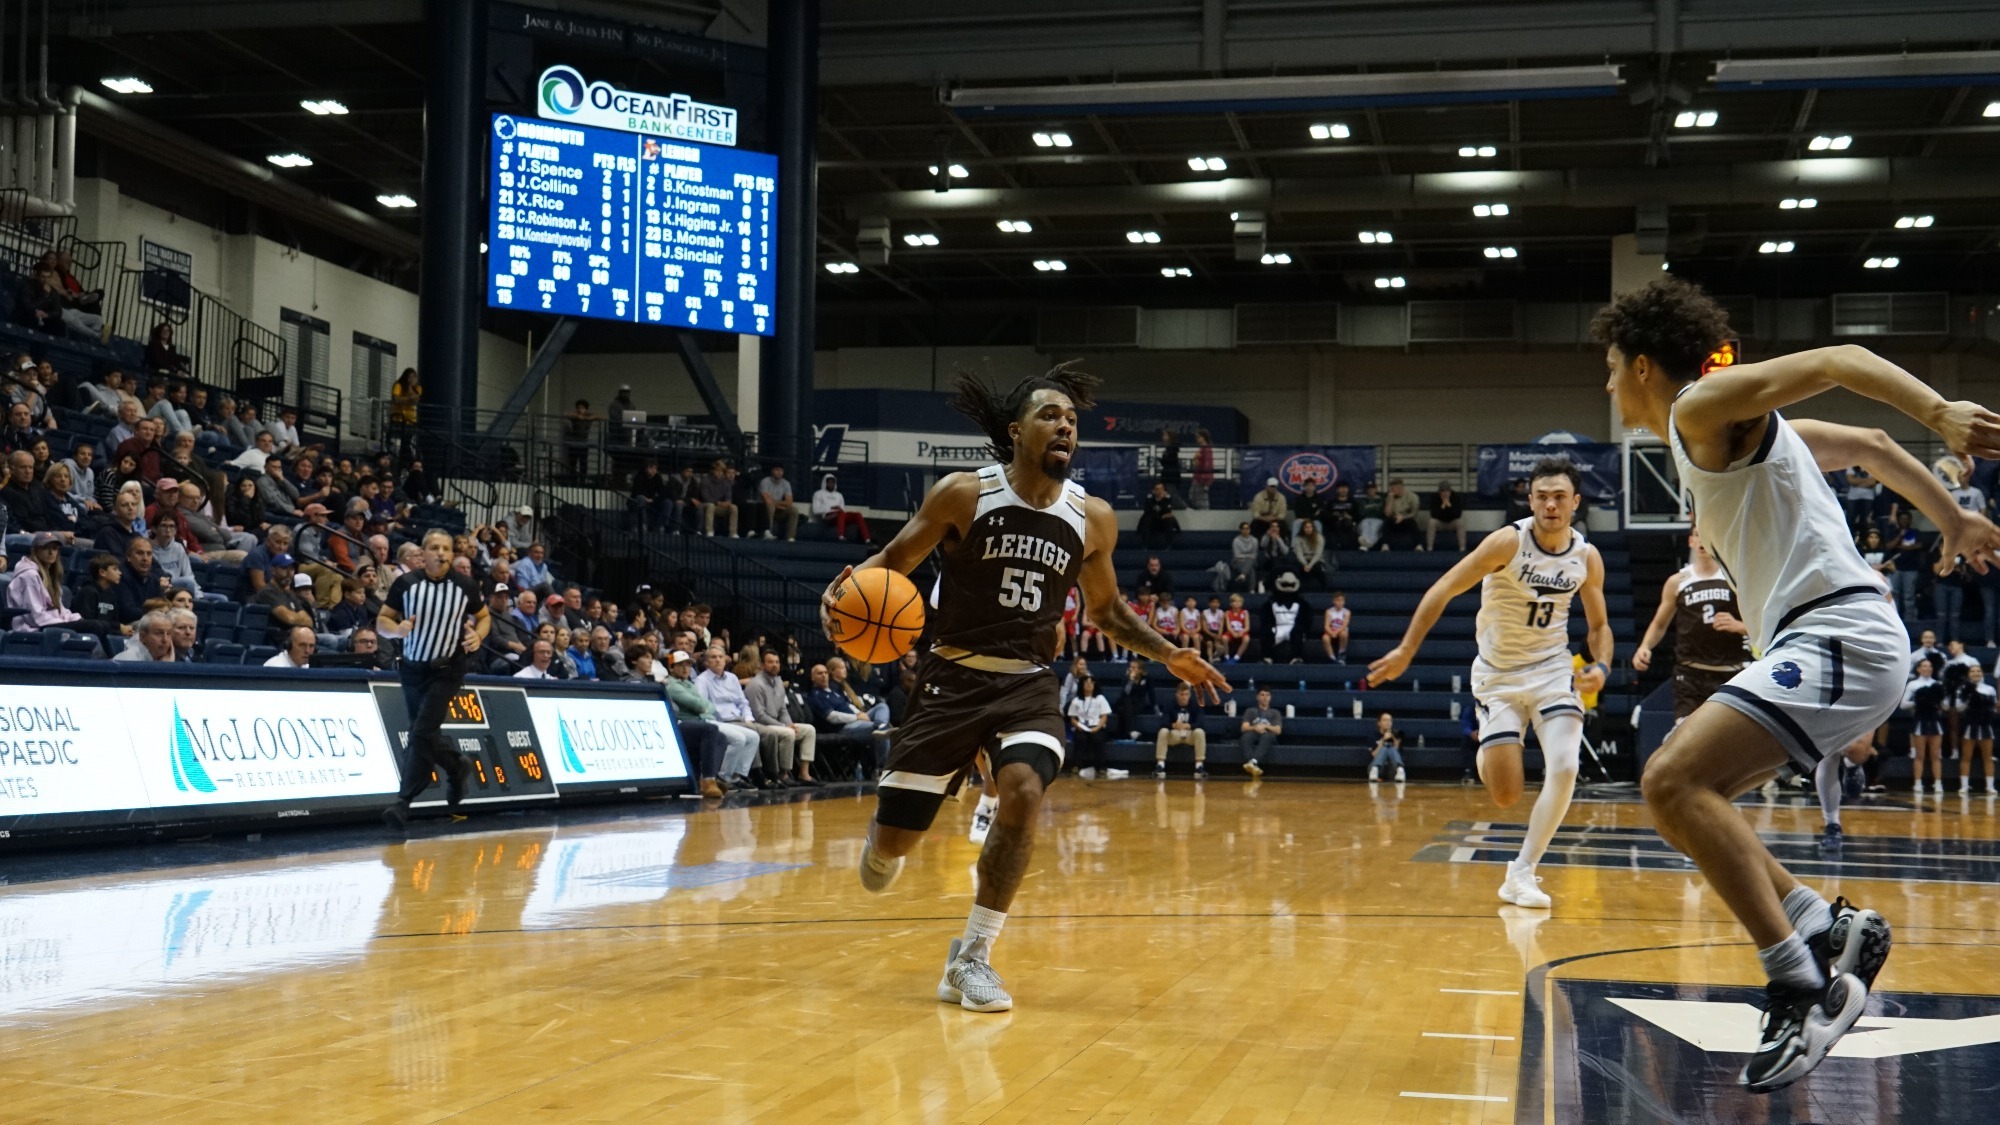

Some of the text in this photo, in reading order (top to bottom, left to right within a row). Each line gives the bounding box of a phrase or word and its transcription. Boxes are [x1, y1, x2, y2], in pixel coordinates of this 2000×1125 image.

[517, 122, 585, 146] MONMOUTH
[628, 117, 733, 143] BANK CENTER
[518, 142, 560, 162] PLAYER
[593, 152, 615, 169] PTS
[617, 156, 637, 173] FLS
[661, 143, 700, 163] LEHIGH
[499, 155, 630, 187] 3 J.Spence 2 1
[663, 163, 702, 182] PLAYER
[733, 173, 754, 190] PTS
[755, 176, 774, 193] FLS
[499, 172, 630, 203] 13 J.Collins 5 1
[646, 175, 656, 190] 2
[663, 178, 734, 201] B.Knostman
[761, 192, 768, 206] 1
[499, 189, 514, 205] 21
[517, 192, 564, 211] X.Rice
[622, 205, 630, 220] 1
[646, 192, 655, 207] 4
[663, 195, 721, 215] J.Ingram
[761, 208, 768, 222] 1
[498, 206, 515, 222] 23
[516, 209, 576, 230] C.Robinson
[579, 217, 591, 231] Jr.
[622, 222, 629, 237] 1
[663, 212, 716, 232] K.Higgins
[719, 219, 733, 233] Jr.
[737, 221, 751, 236] 14
[760, 224, 768, 239] 1
[498, 223, 515, 240] 25
[601, 236, 611, 251] 4
[622, 239, 629, 254] 1
[663, 228, 724, 249] B.Momah
[760, 241, 768, 255] 1
[662, 245, 724, 265] J.Sinclair
[760, 257, 767, 271] 1
[542, 293, 552, 308] 2
[581, 297, 590, 312] 7
[688, 310, 698, 325] 4
[981, 533, 1072, 576] LEHIGH
[998, 567, 1046, 613] 55
[1518, 563, 1574, 592] Hawks
[1684, 587, 1731, 606] LEHIGH
[1527, 601, 1554, 628] 13
[1702, 604, 1715, 624] 2
[181, 717, 366, 762] McLOONE'S
[458, 738, 481, 751] PERIOD
[507, 731, 532, 747] GUEST
[560, 719, 665, 752] McLOONE'S
[235, 768, 347, 788] RESTAURANTS
[475, 760, 486, 783] 1
[519, 752, 541, 779] 40
